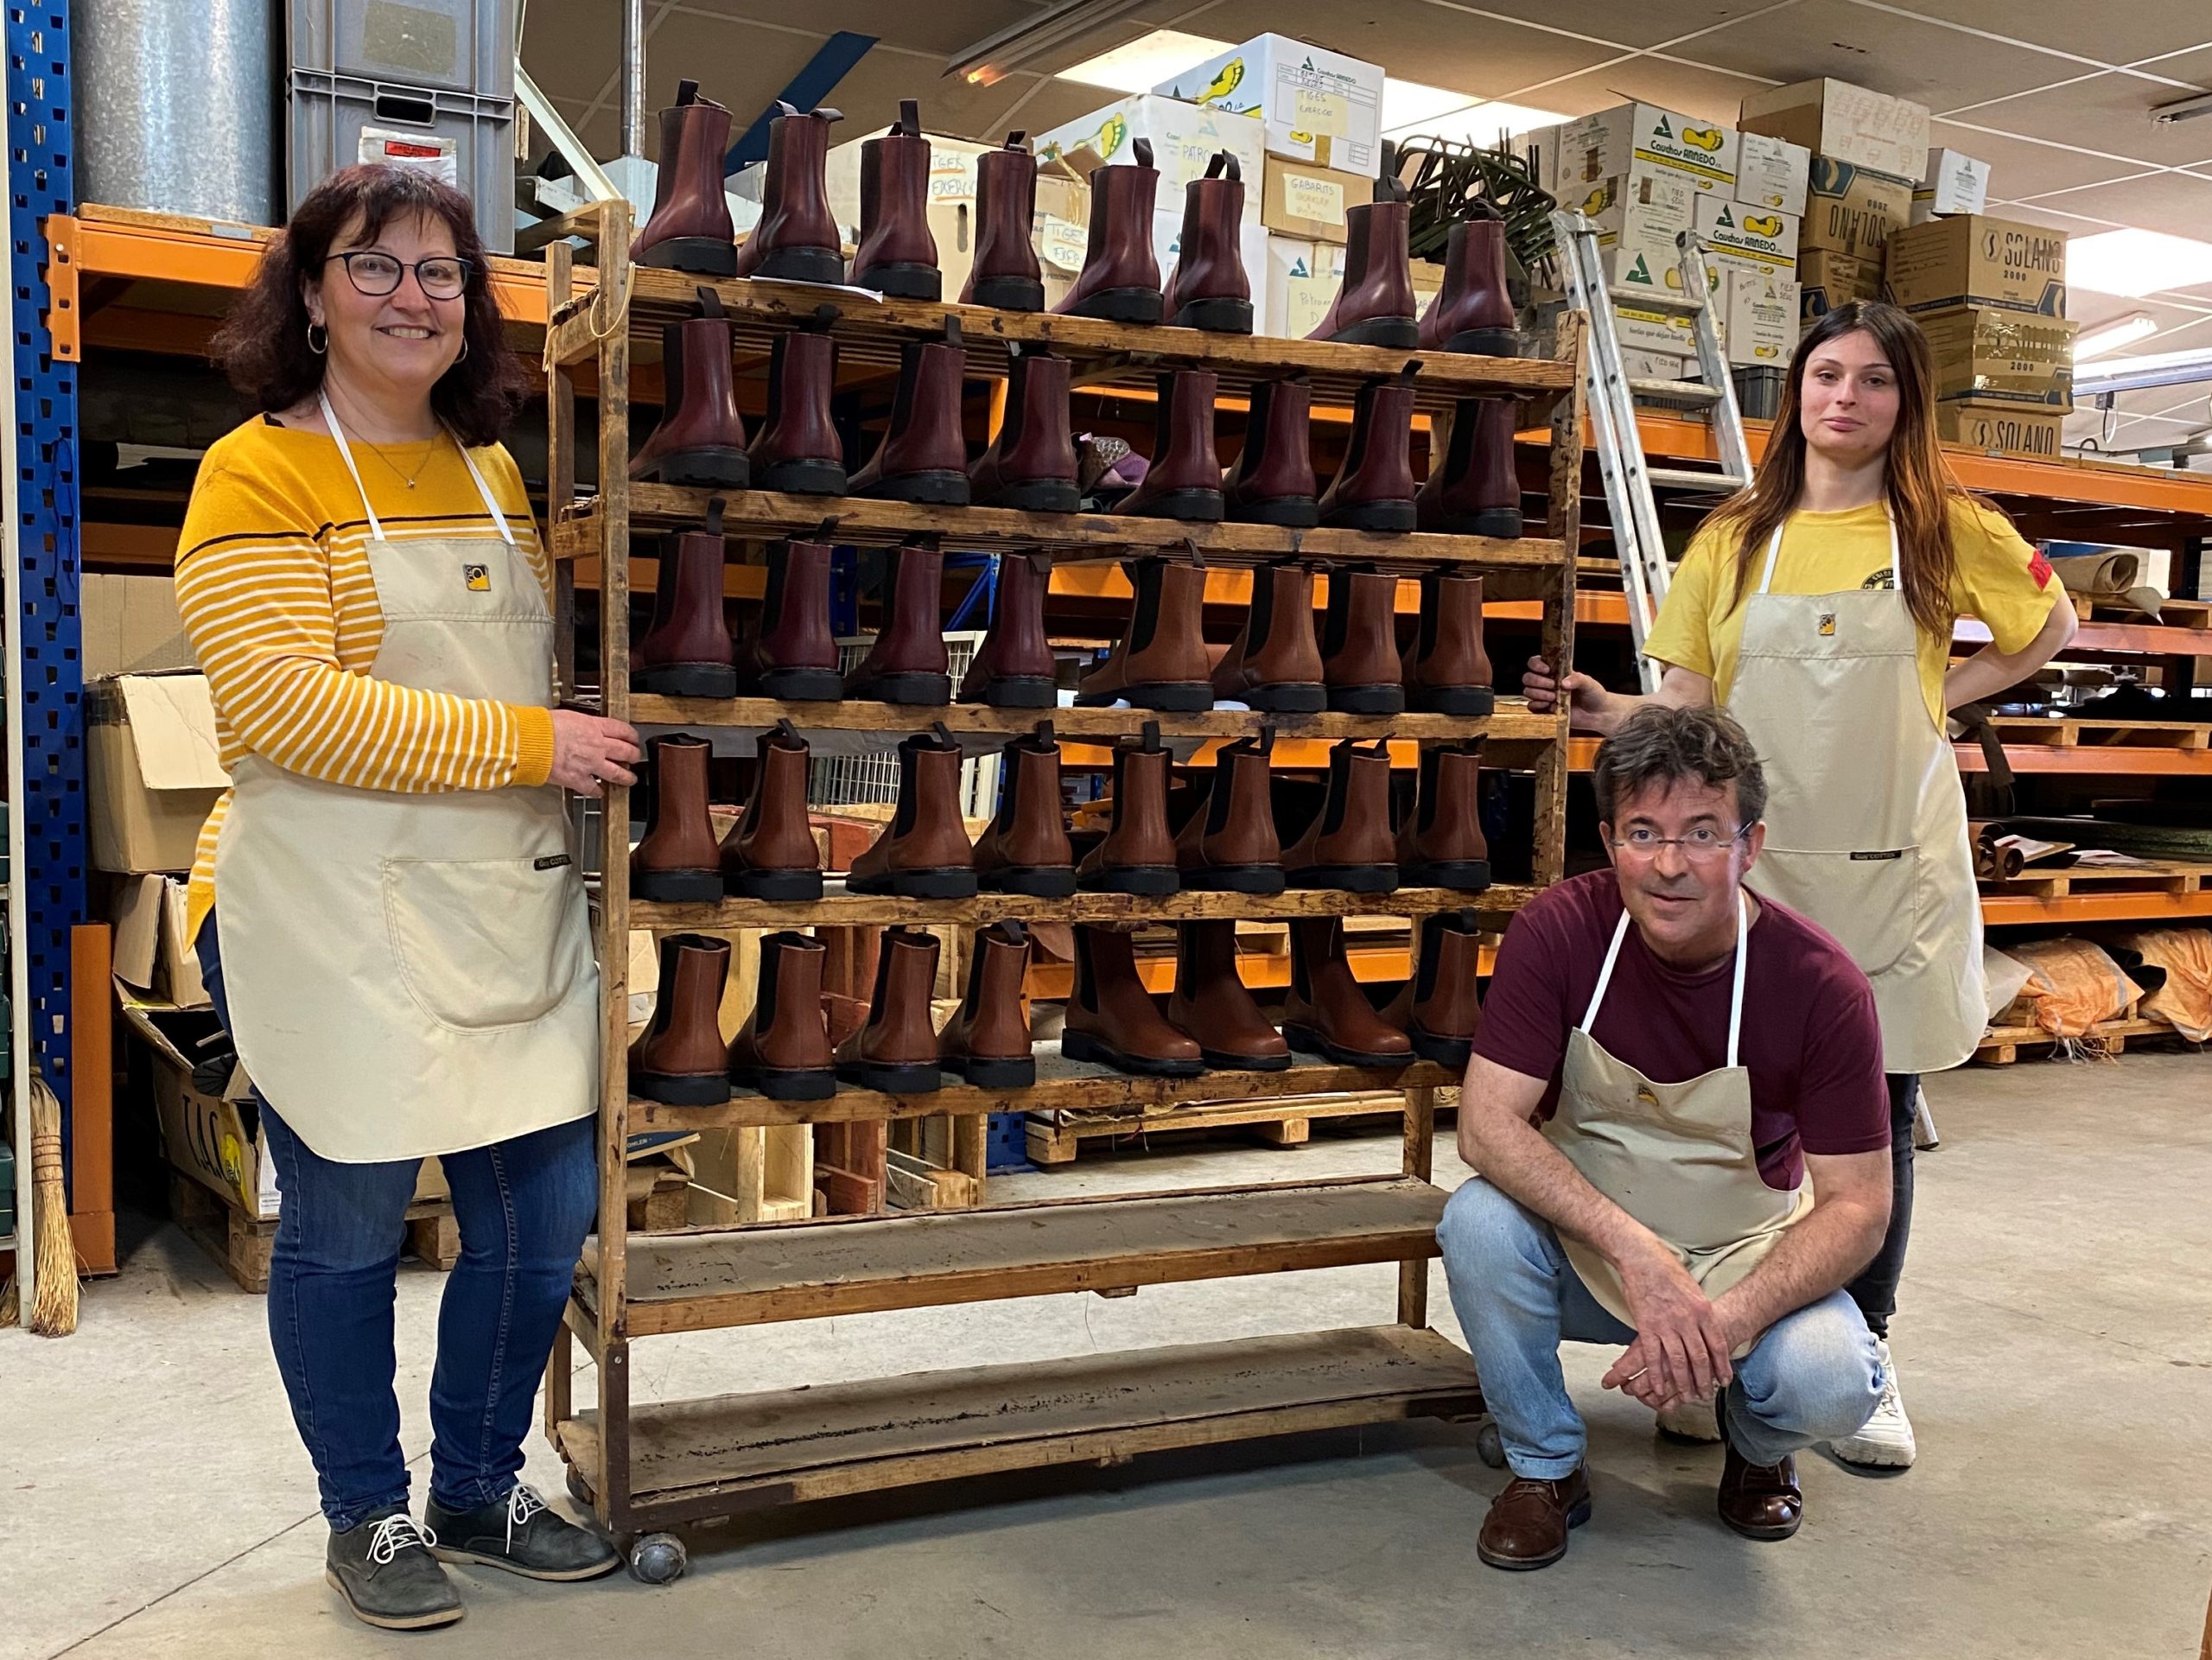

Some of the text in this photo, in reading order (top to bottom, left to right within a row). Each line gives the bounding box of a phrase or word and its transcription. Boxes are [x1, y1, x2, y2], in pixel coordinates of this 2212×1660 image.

[1650, 139, 1682, 157] Cauchos
[1683, 149, 1716, 166] ARNEDO
[1291, 178, 1335, 195] GABARITS
[1866, 199, 1888, 212] 2000
[1828, 204, 1886, 249] SOLANO
[1713, 230, 1745, 242] Cauchos
[1745, 237, 1777, 252] ARNEDO
[2004, 232, 2063, 274] SOLANO
[2004, 270, 2026, 282] 2000
[2011, 361, 2034, 372] 2000
[1995, 421, 2054, 455] SOLANO
